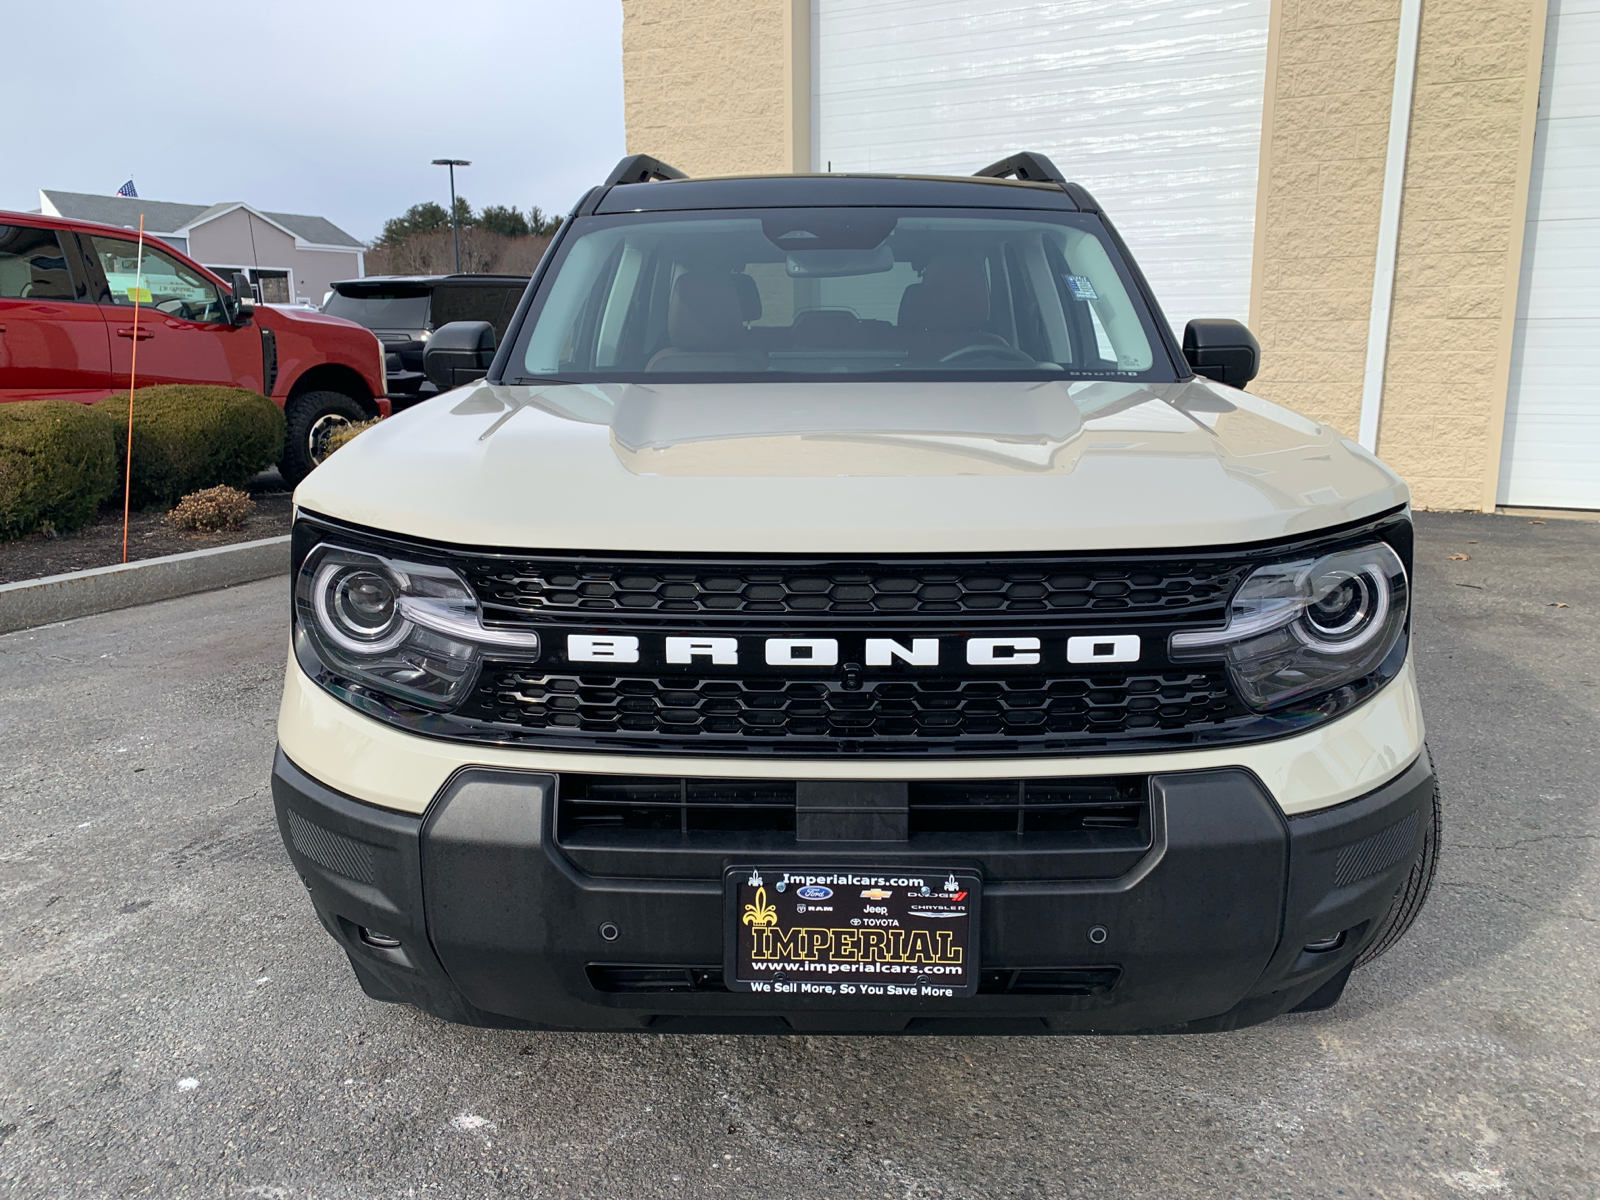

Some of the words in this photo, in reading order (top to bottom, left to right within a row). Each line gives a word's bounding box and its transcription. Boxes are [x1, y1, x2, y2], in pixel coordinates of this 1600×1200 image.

[567, 634, 1141, 666] BRONCO
[783, 873, 924, 887] Imperialcars.com
[804, 888, 825, 898] Ford
[863, 904, 887, 915] Jeep
[863, 918, 899, 927] TOYOTA
[751, 927, 963, 963] IMPERIAL
[751, 961, 963, 975] www.imperialcars.com
[750, 982, 771, 993] We
[774, 982, 797, 993] Sell
[801, 983, 836, 995] More,
[839, 984, 856, 995] So
[859, 984, 884, 995] You
[887, 985, 918, 996] Save
[921, 986, 953, 997] More
